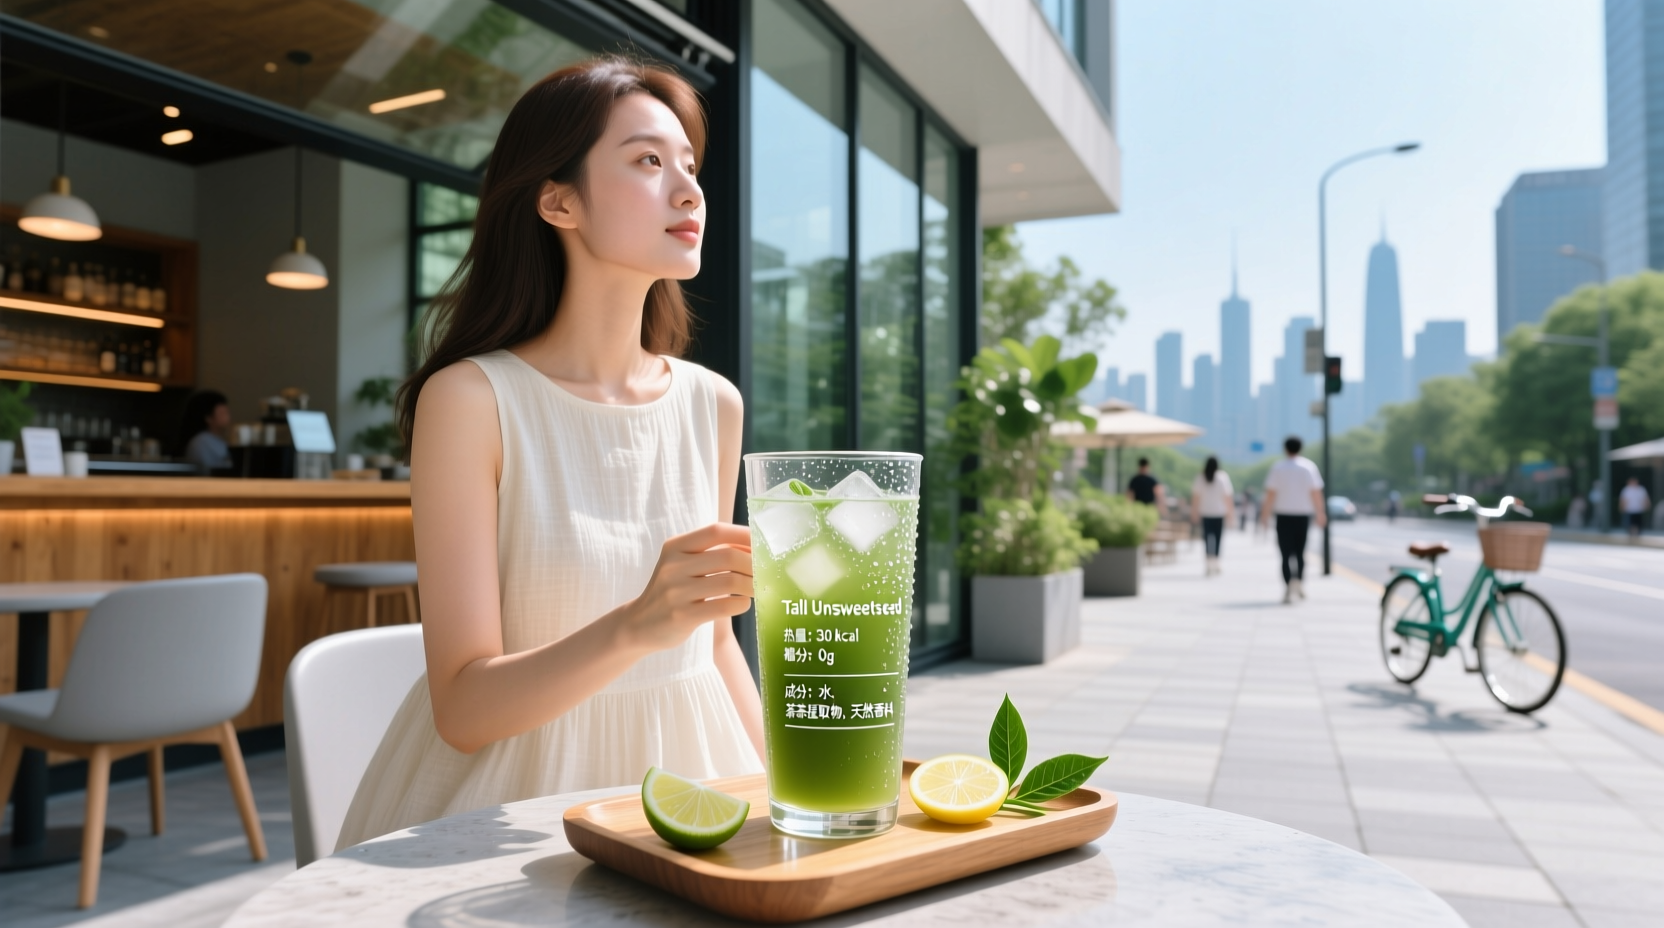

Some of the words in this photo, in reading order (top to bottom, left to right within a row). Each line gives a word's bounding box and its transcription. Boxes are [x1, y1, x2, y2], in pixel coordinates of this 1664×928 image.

[781, 599, 808, 615] Tall
[816, 628, 833, 643] 30
[834, 627, 859, 643] kcal
[818, 647, 835, 666] 0g
